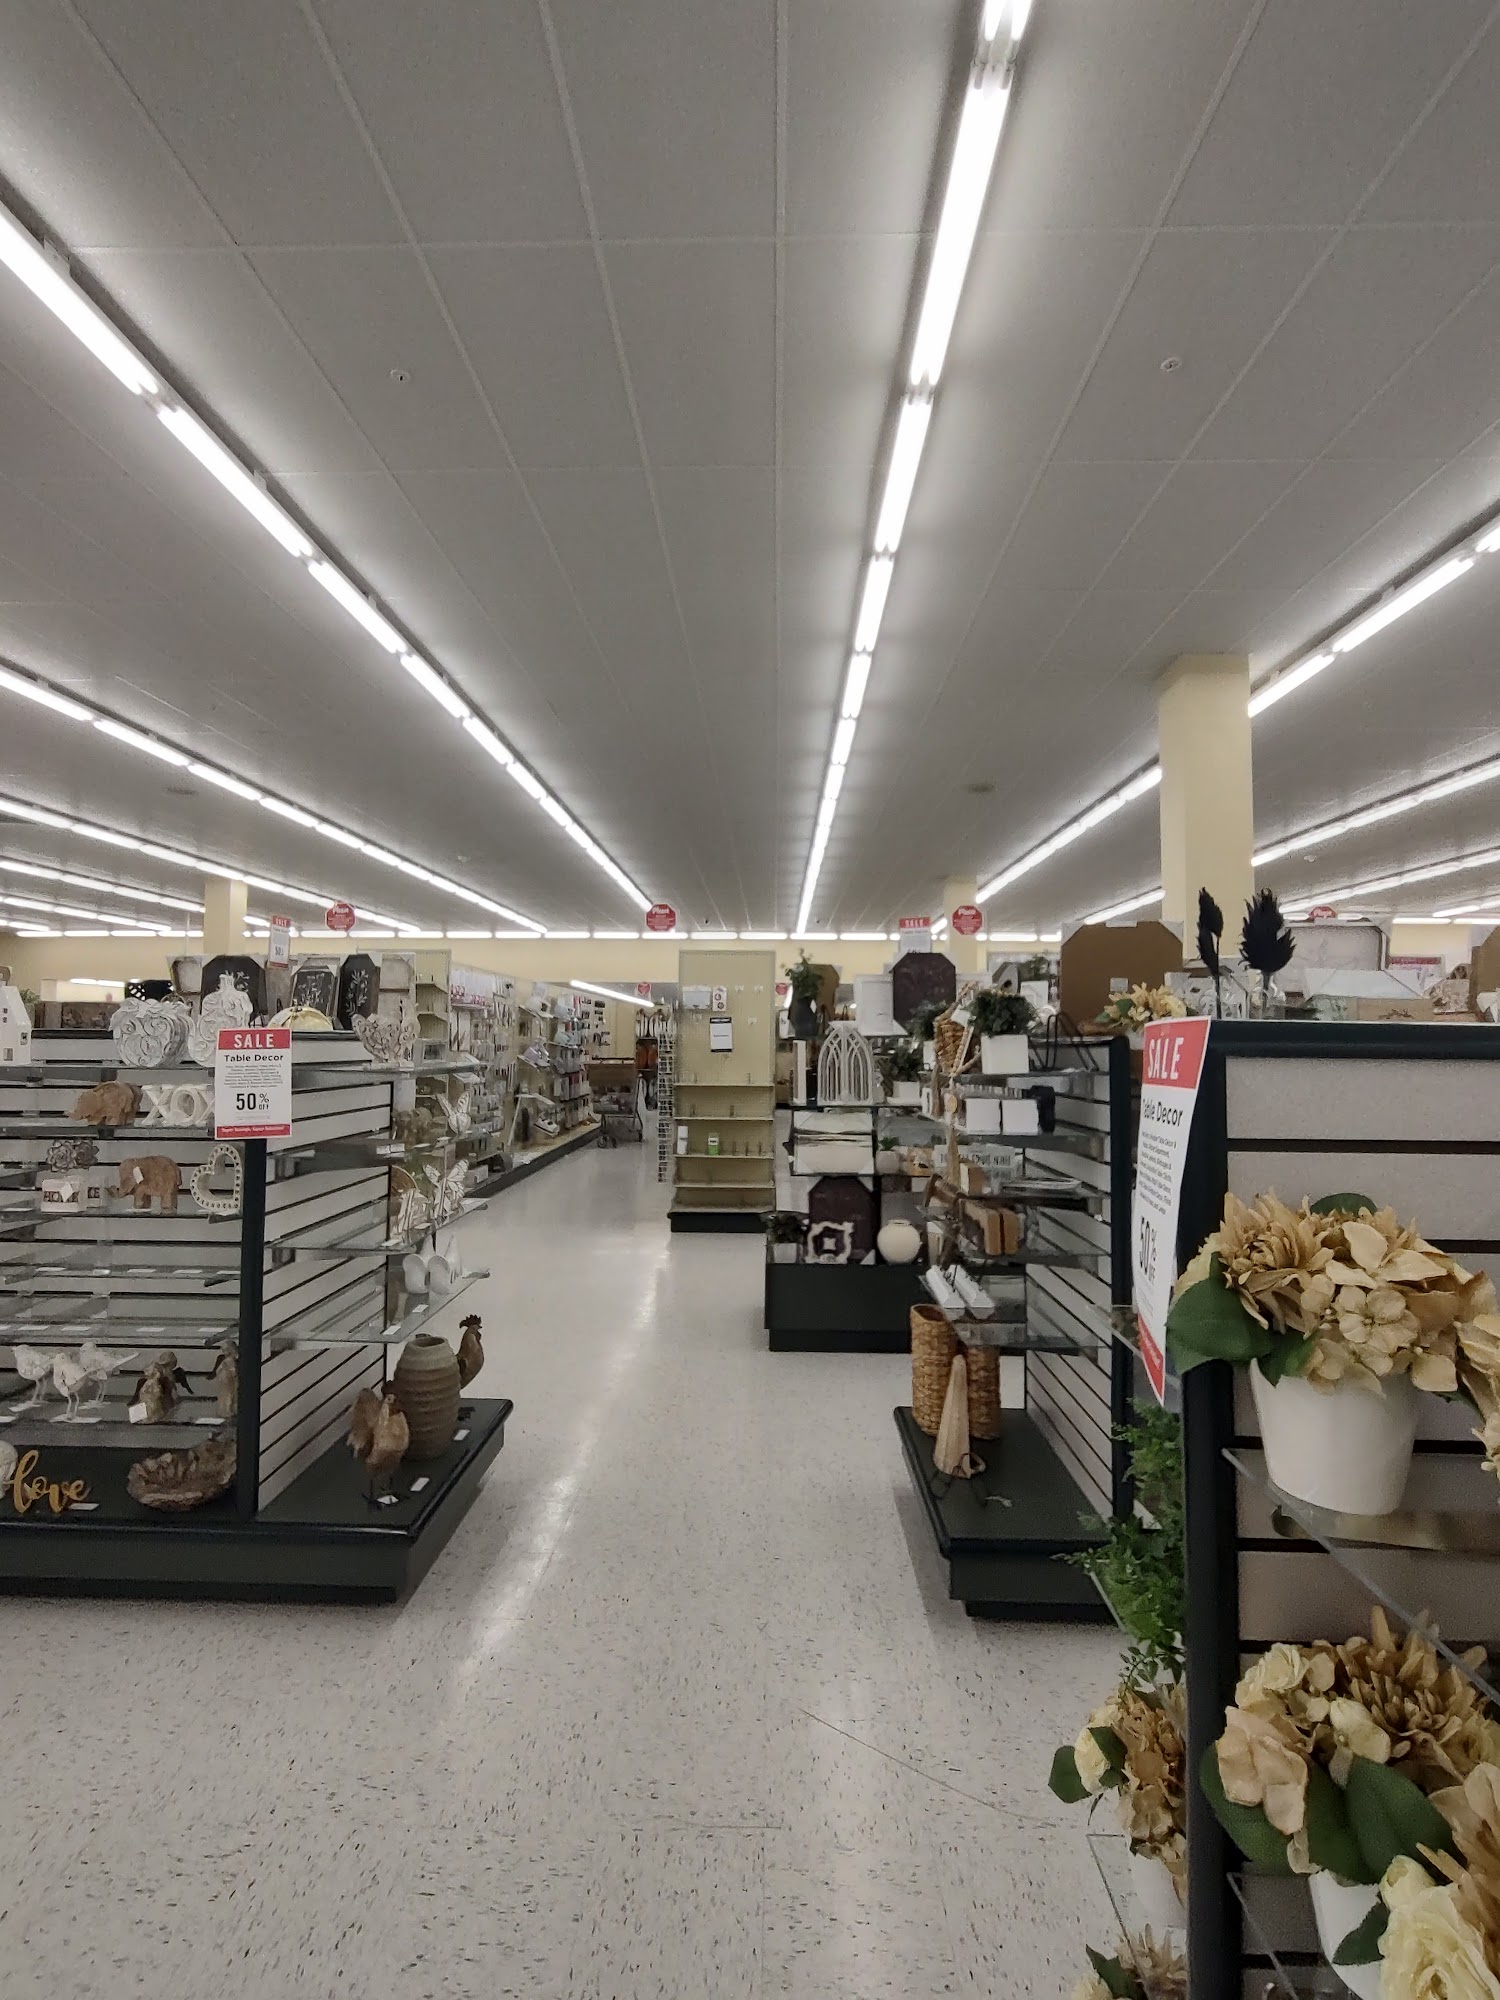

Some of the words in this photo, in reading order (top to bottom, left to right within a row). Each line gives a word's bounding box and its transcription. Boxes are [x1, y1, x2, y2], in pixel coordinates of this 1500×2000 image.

[233, 1033, 275, 1049] SALE
[224, 1054, 251, 1062] Table
[254, 1054, 284, 1062] Decor
[1147, 1036, 1185, 1080] SALE
[1156, 1101, 1184, 1127] Decor
